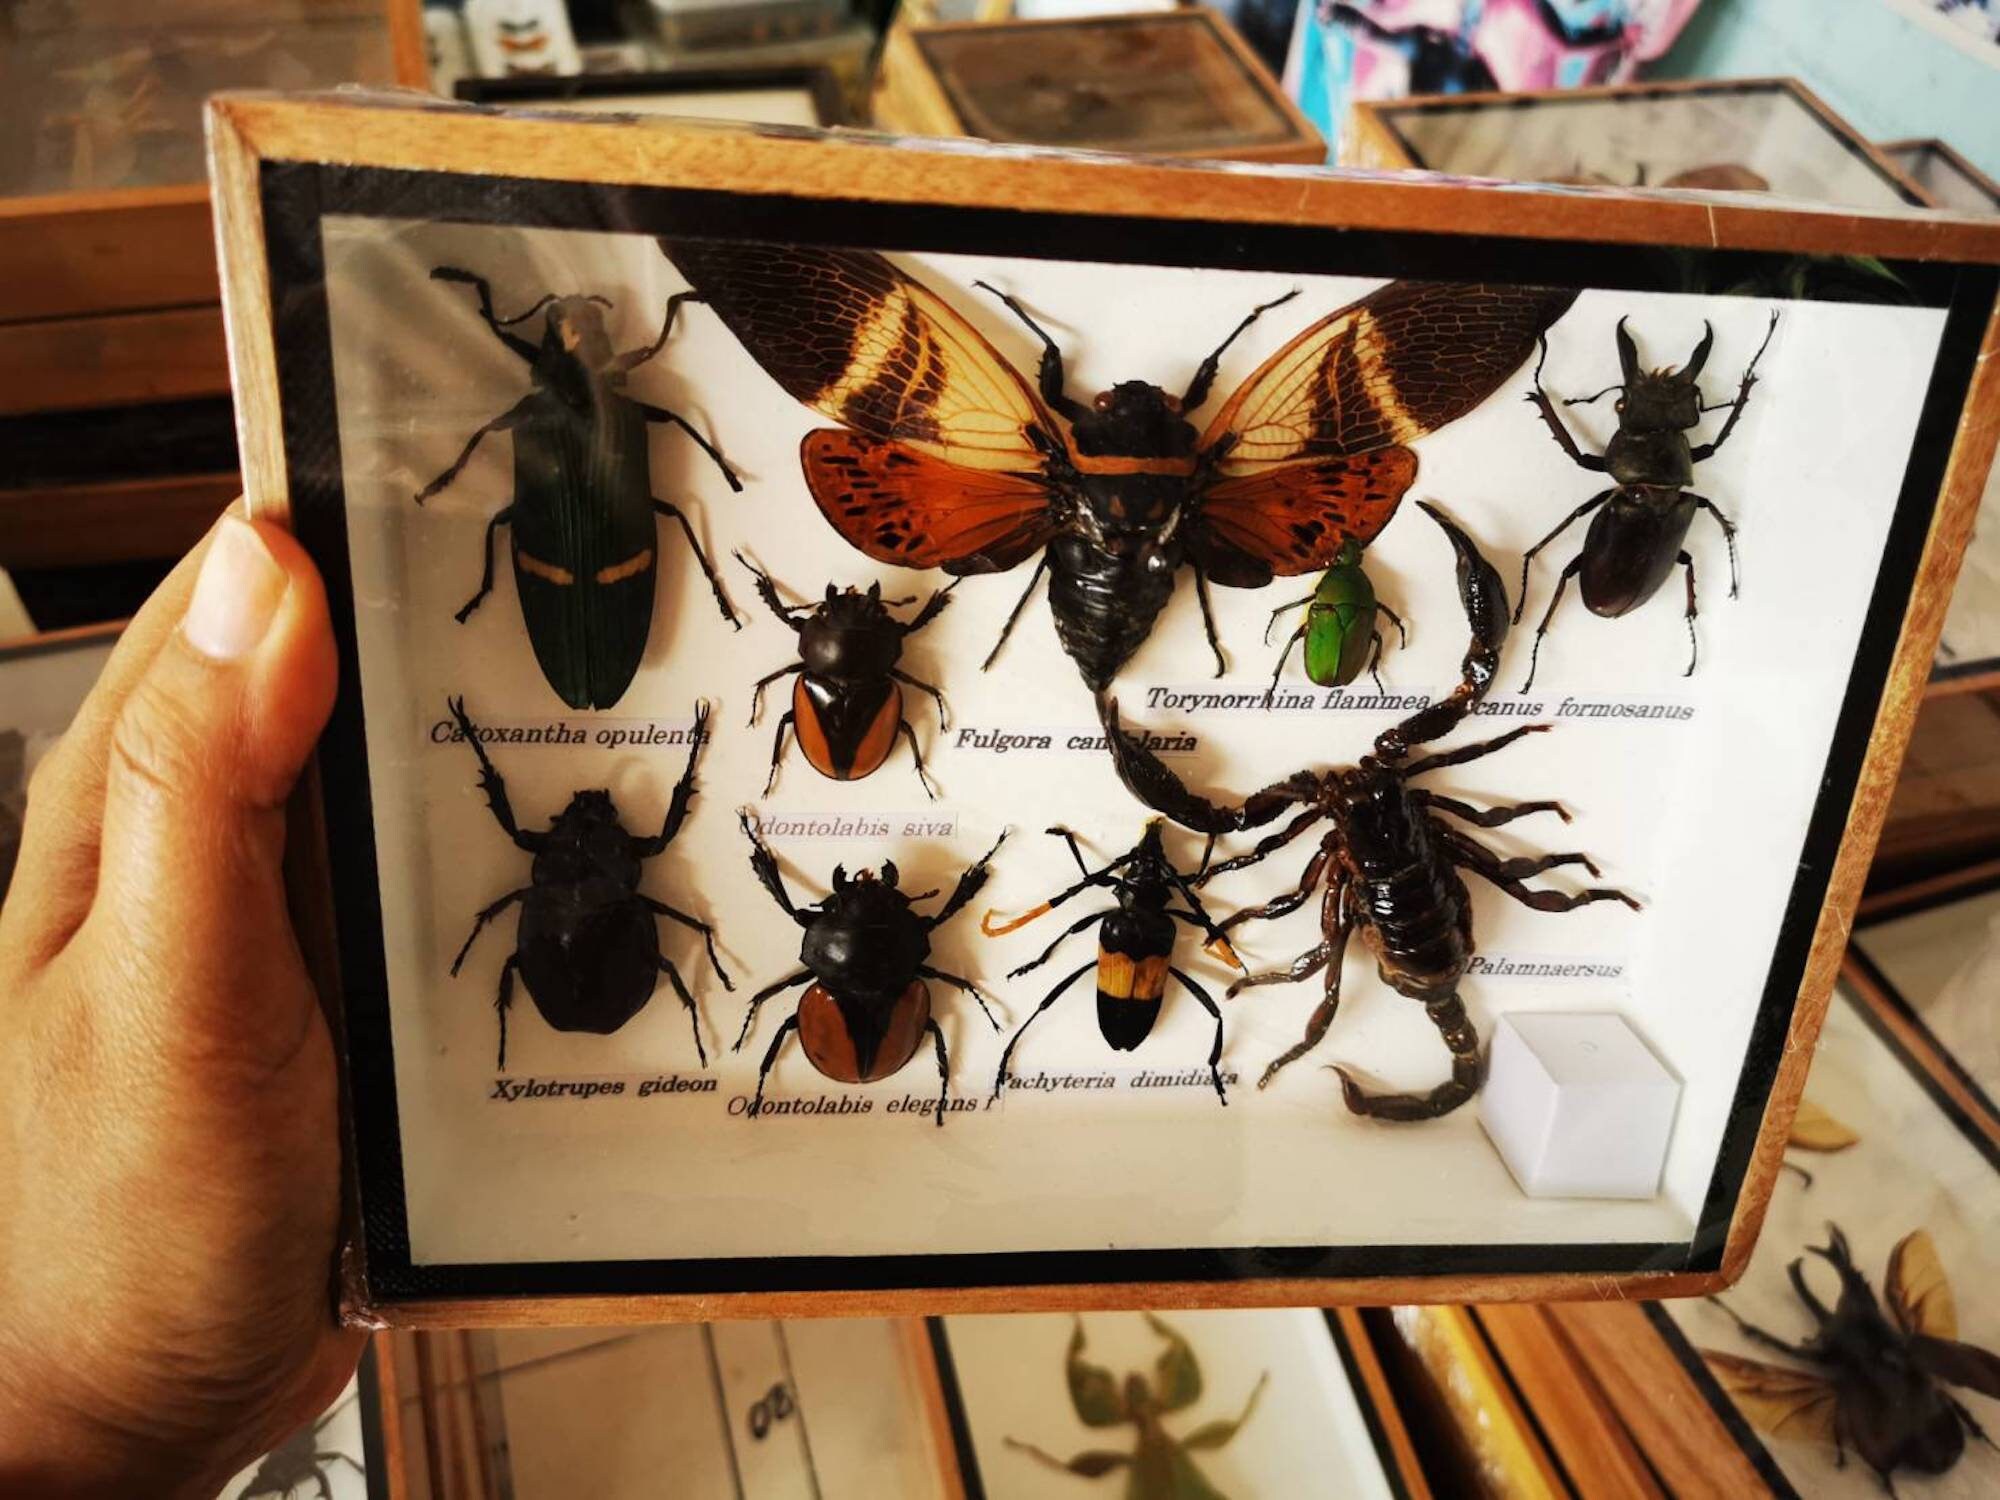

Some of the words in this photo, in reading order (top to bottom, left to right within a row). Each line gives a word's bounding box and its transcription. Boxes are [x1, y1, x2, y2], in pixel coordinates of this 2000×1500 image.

[1147, 687, 1315, 713] Torynorrhina
[1322, 688, 1431, 710] flammea
[1472, 700, 1544, 716] canus
[1554, 697, 1695, 721] formosanus
[595, 723, 712, 749] opulenta
[953, 728, 1052, 754] Fulgora
[739, 816, 890, 837] Odontolabis
[902, 816, 953, 837] siva
[1464, 956, 1623, 978] Palamnaersus
[491, 1078, 626, 1102] Xylotrupes
[638, 1075, 718, 1097] gideon
[727, 1094, 873, 1117] Odontolabis
[886, 1094, 978, 1117] elegans
